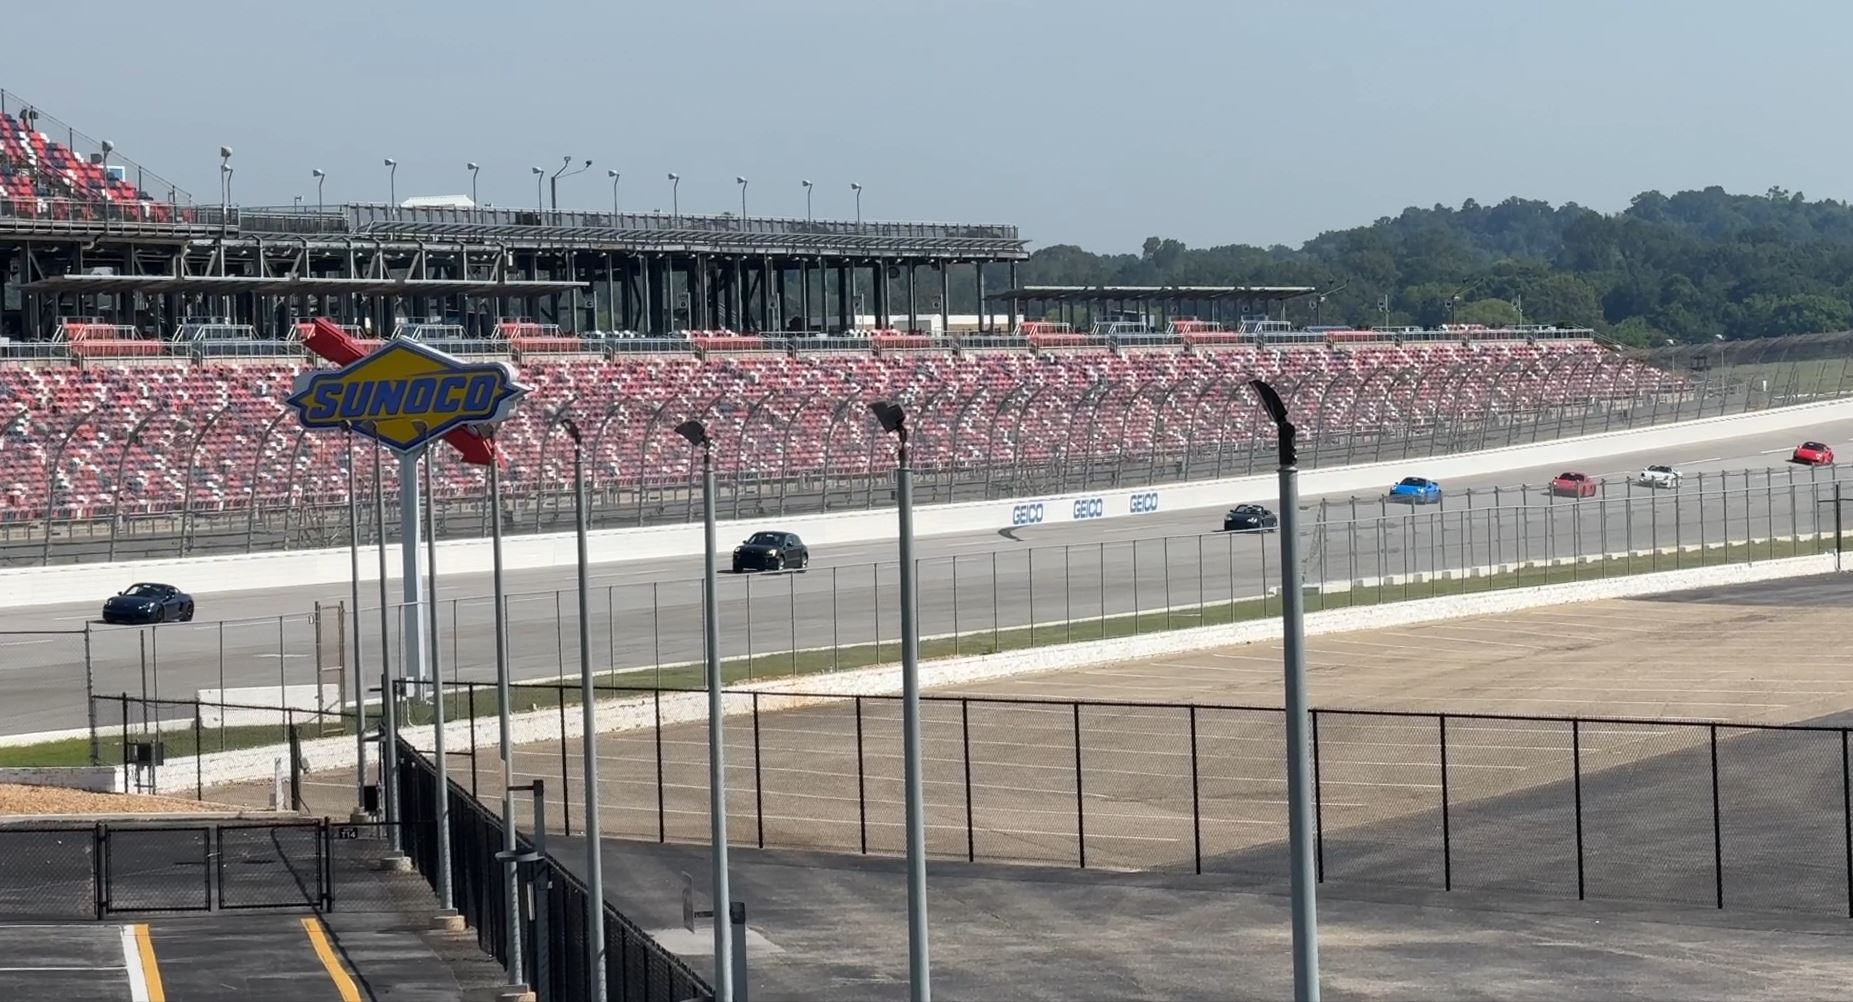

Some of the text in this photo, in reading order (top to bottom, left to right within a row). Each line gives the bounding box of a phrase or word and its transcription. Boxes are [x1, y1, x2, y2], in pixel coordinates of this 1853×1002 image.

[309, 375, 497, 419] SUNOCO
[1073, 498, 1103, 519] GEICO
[1130, 493, 1158, 513] GEICO
[1013, 503, 1043, 525] GEICO
